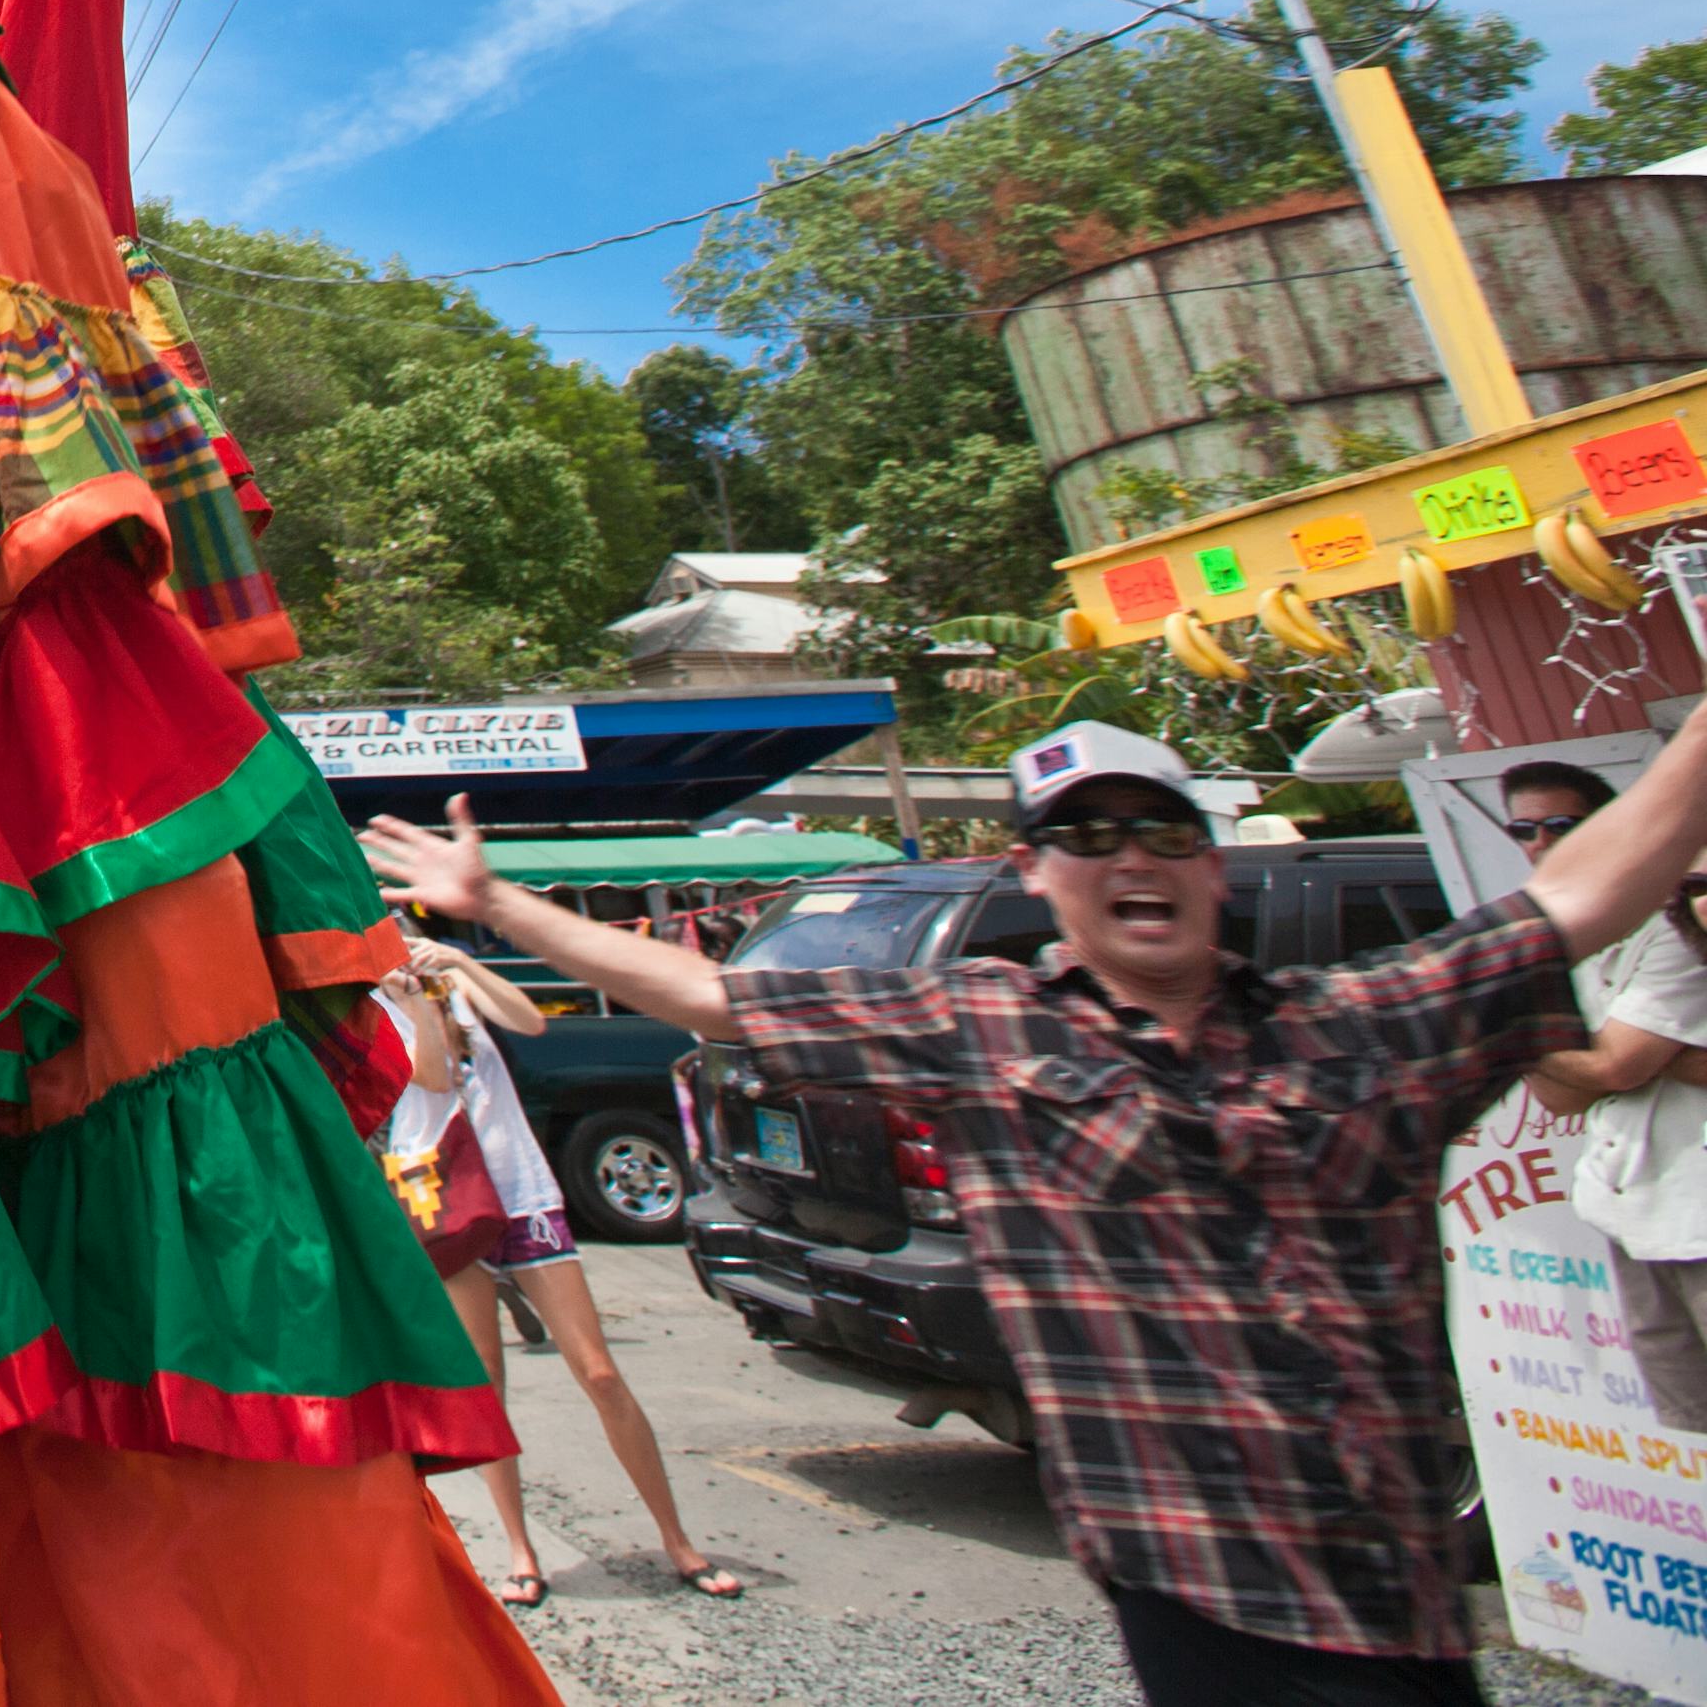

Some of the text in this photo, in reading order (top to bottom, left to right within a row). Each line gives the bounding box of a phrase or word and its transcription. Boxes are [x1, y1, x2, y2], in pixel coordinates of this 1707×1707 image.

[1588, 448, 1691, 500] Beers
[1422, 482, 1517, 539] Drinks
[290, 713, 565, 738] NZIL CLYNE
[323, 743, 346, 759] &
[358, 741, 431, 757] CAR
[433, 736, 561, 756] RENTAL
[1439, 1148, 1568, 1235] TRE
[1465, 1244, 1611, 1292] ICE CREAM
[1499, 1300, 1631, 1350] MILK SH
[1509, 1355, 1585, 1396] MALT
[1510, 1408, 1631, 1464] BANANA
[1568, 1530, 1707, 1601] ROOT BEE
